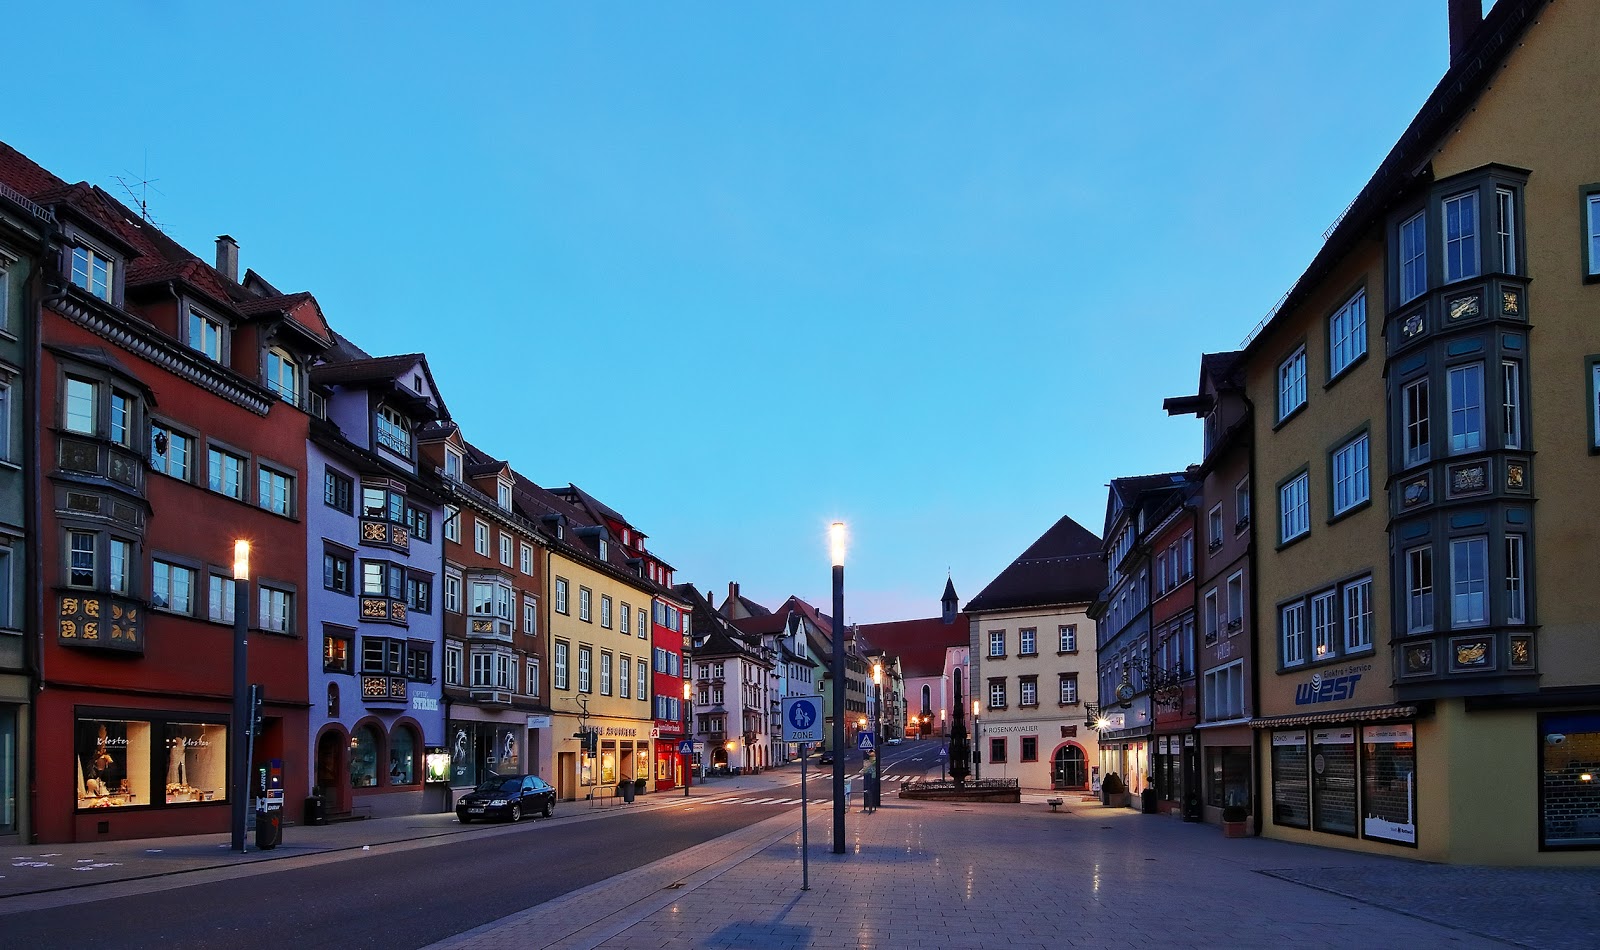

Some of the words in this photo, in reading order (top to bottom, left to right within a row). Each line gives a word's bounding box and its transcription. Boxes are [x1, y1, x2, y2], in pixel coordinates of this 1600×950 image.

[1323, 669, 1344, 678] Elektro
[1349, 664, 1372, 674] Service
[988, 725, 1038, 733] ROSENKAVALIER
[792, 731, 813, 739] ZONE
